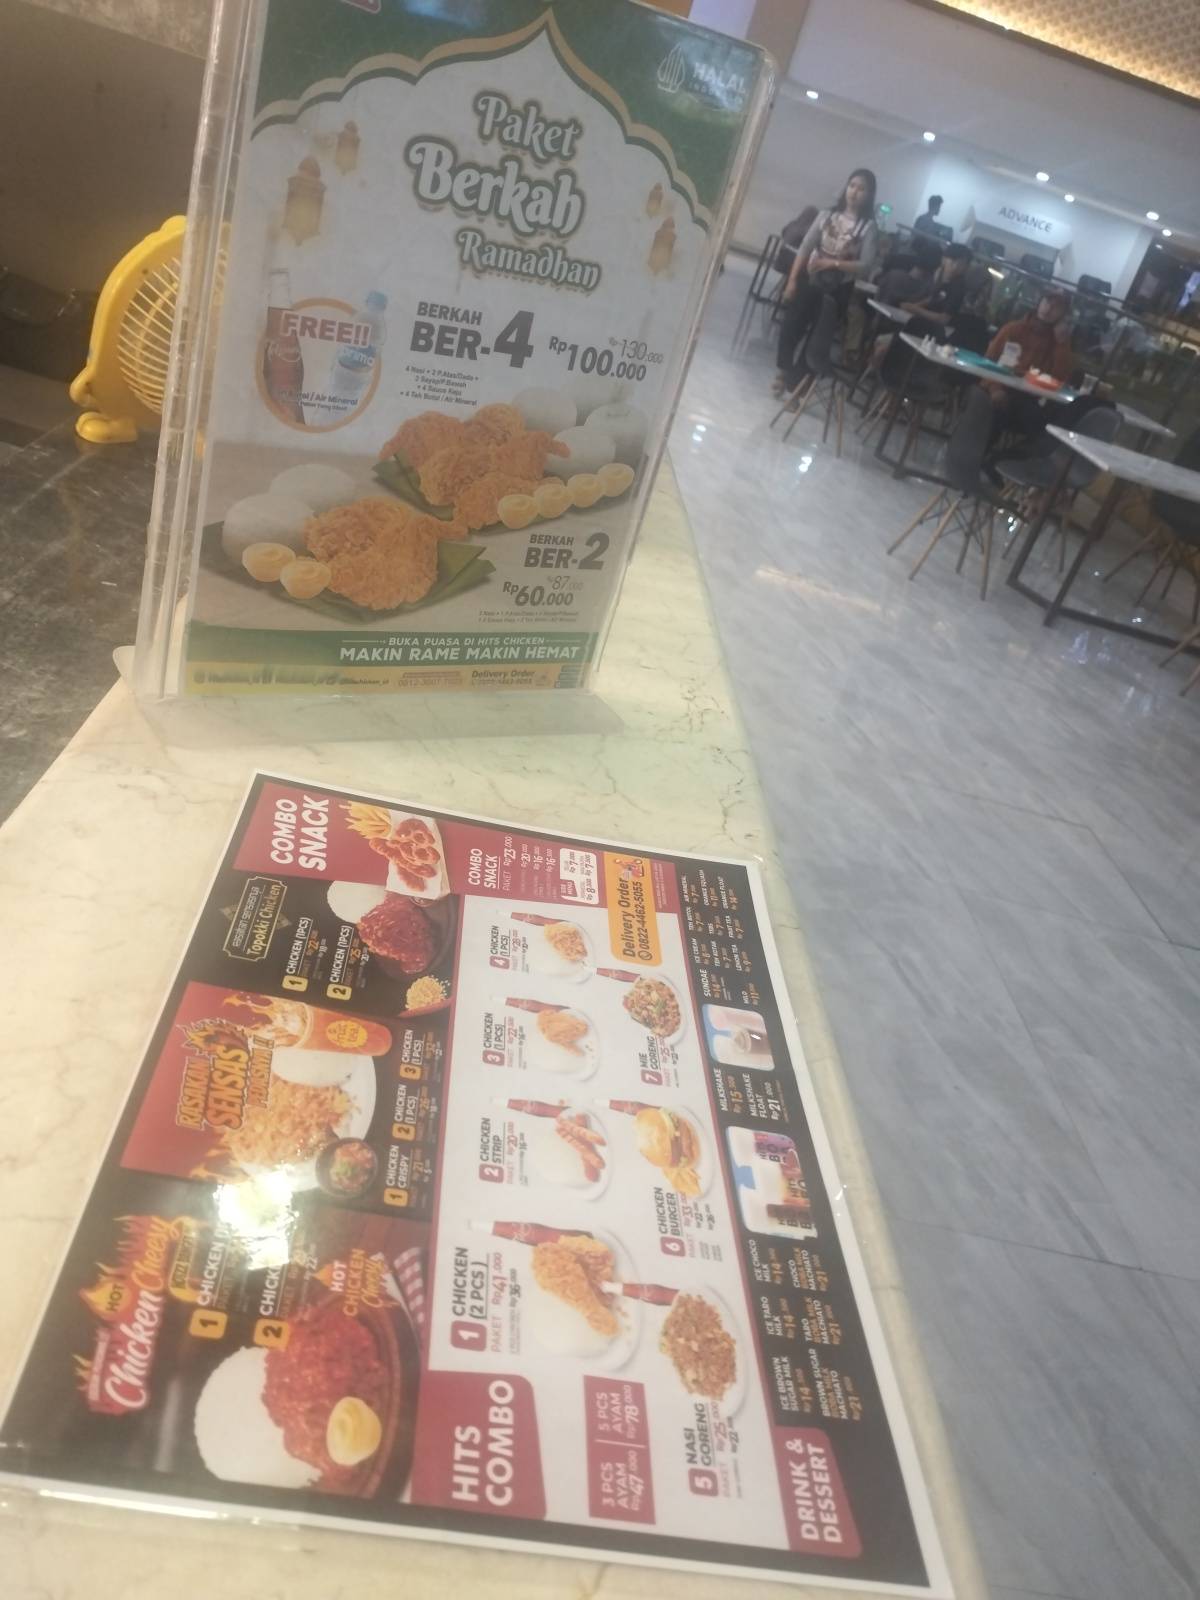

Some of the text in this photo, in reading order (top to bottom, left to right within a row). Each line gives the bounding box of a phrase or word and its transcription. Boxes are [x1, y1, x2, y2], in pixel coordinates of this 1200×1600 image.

[475, 92, 582, 161] Paket
[405, 137, 585, 235] Berkah
[999, 206, 1052, 233] ADVANCE
[457, 229, 600, 290] Ramadhan
[281, 312, 370, 347] FREE!!
[417, 301, 482, 326] BERKAH
[530, 534, 574, 546] BERKAH
[340, 646, 580, 661] MAKIN RAME MAKIN HEMAT
[389, 637, 544, 646] BUKA PUASA DI HITS CHICKEN
[270, 798, 298, 865] COMBO
[298, 795, 330, 871] SNACK
[467, 848, 483, 885] COMBO
[484, 855, 498, 889] SNACK
[246, 884, 281, 955] Topokki Chicken
[617, 878, 636, 957] Delivery Order
[286, 940, 303, 974] CHICKEN
[490, 925, 499, 955] CHICKEN
[330, 948, 346, 983] CHICKEN
[699, 969, 711, 997] SUNDAE
[401, 1029, 413, 1063] CHICKEN
[483, 1012, 500, 1063] 3 CHICKEN
[647, 1036, 659, 1070] GORENG
[638, 1052, 658, 1082] 7 MIE
[179, 1057, 210, 1127] RASAKAN
[394, 1084, 410, 1135] 2 CHICKEN
[713, 1068, 729, 1112] MILKSHAKE
[742, 1072, 758, 1117] MILKSHAKE
[755, 1094, 768, 1119] FLOAT
[386, 1145, 399, 1186] CHICKEN
[479, 1117, 498, 1177] 2 CHICKEN
[492, 1134, 502, 1164] STRIP
[397, 1154, 409, 1188] CRISPY
[653, 1187, 679, 1252] 6 CHICKEN
[666, 1192, 681, 1236] BURGER
[197, 1241, 225, 1306] CHICKEN
[330, 1260, 348, 1292] HOT
[748, 1239, 763, 1281] ICE CHOCO
[761, 1263, 771, 1282] MILK
[788, 1259, 801, 1288] CHOCO
[105, 1283, 124, 1313] HOT
[344, 1248, 366, 1317] CHICKEN
[451, 1246, 479, 1340] 1 CHICKEN
[104, 1215, 179, 1409] Chicken Cheesy
[199, 1318, 219, 1328] 1
[262, 1326, 282, 1339] 2
[760, 1296, 776, 1336] ICE TARO
[773, 1315, 784, 1336] MILK
[801, 1317, 813, 1342] TARO
[491, 1316, 502, 1353] PAKET
[772, 1357, 791, 1410] ICE BROWN
[780, 1355, 800, 1412] SUGAR MILK
[808, 1348, 831, 1417] BROWN SUGAR
[830, 1370, 848, 1420] MACHIATO
[485, 1379, 514, 1506] COMBO
[596, 1391, 615, 1508] 3 PCS 5 PCS
[610, 1393, 629, 1510] AYAM AYAM
[694, 1402, 712, 1467] GORENG
[452, 1425, 481, 1502] HITS
[683, 1427, 711, 1490] 5 NASI
[785, 1438, 819, 1541] DRINK &
[807, 1443, 843, 1543] DESSERT
